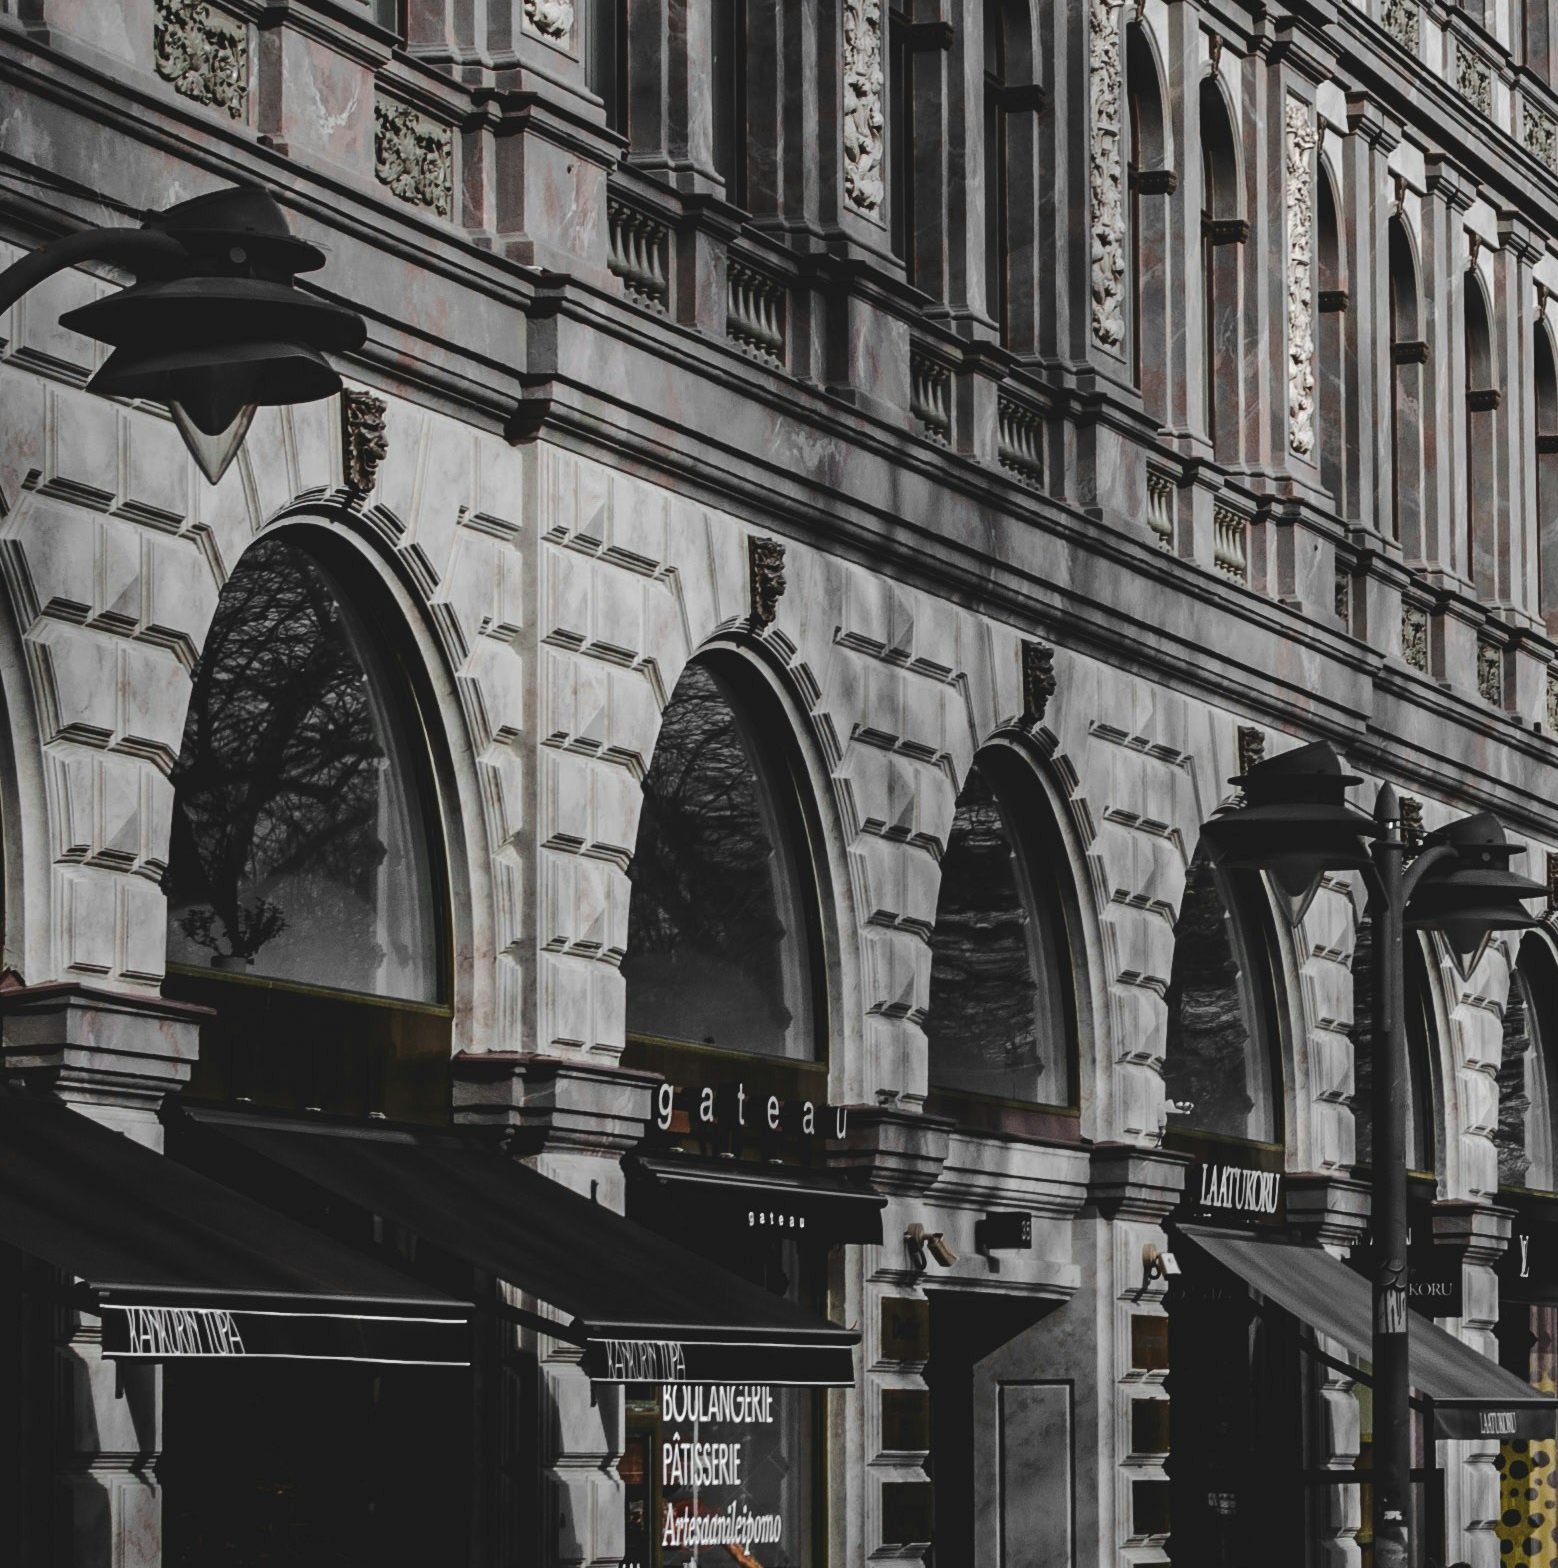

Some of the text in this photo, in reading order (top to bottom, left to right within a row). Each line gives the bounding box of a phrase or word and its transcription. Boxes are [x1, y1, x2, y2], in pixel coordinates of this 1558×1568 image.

[657, 1083, 848, 1140] gateau
[1200, 1163, 1280, 1214] LAATUKORU
[748, 1211, 805, 1229] gateau
[196, 1309, 247, 1355] TUPA
[655, 1342, 686, 1381] TUPA
[662, 1385, 774, 1424] BOULANGERIE
[1479, 1411, 1517, 1435] LAATUKORU
[662, 1431, 742, 1487] PÂTISSERIE
[661, 1500, 783, 1556] Artesaanileipomo
